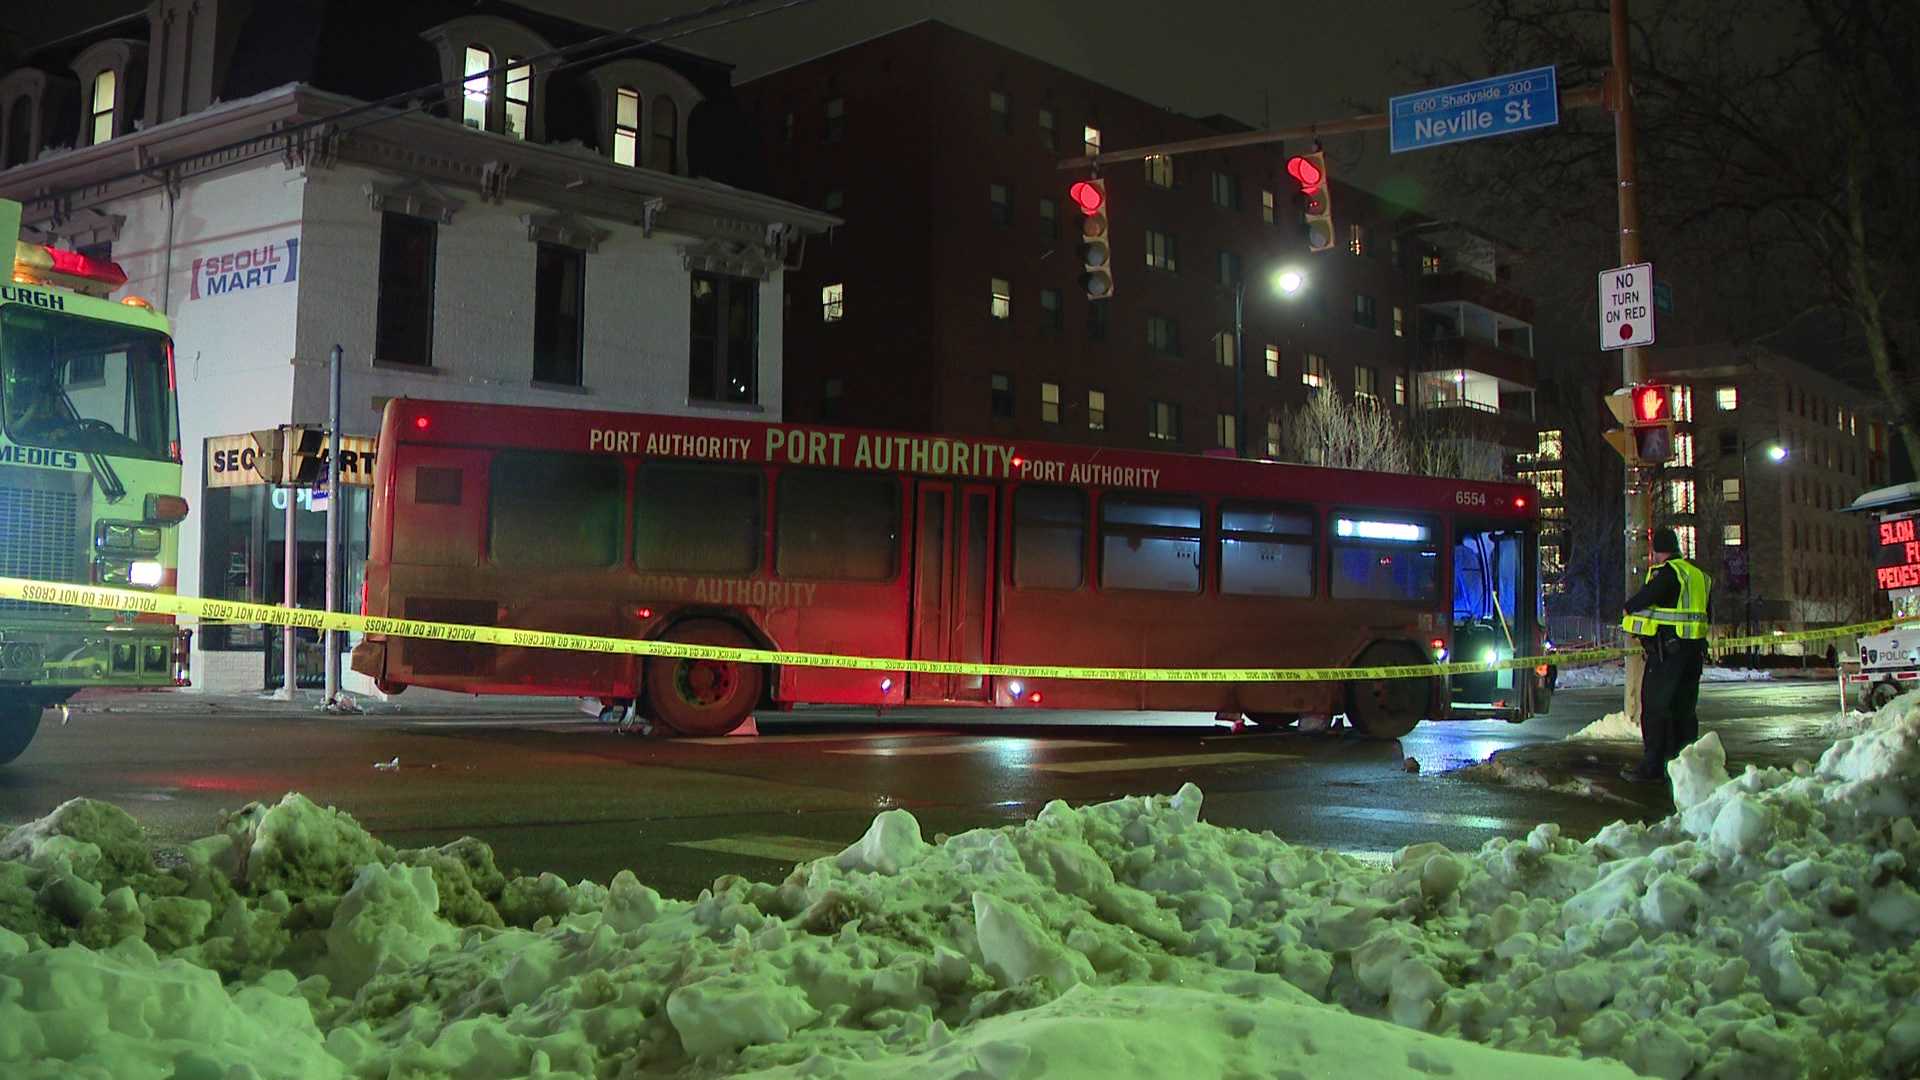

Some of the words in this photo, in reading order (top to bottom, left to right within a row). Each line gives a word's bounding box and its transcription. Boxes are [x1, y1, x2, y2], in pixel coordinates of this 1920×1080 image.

[1413, 99, 1436, 113] 600
[1441, 87, 1500, 109] Shadyside
[1508, 80, 1532, 96] 200
[1415, 108, 1493, 141] Neville
[1504, 98, 1532, 124] St
[206, 244, 280, 276] SEOUL
[207, 264, 277, 296] MART
[1616, 272, 1634, 289] NO
[1611, 291, 1640, 306] TURN
[1606, 310, 1620, 323] ON
[1625, 306, 1646, 320] RED
[589, 428, 641, 454] PORT
[646, 432, 751, 460] AUTHORITY
[766, 427, 845, 467] PORT
[854, 434, 1015, 479] AUTHORITY
[1021, 458, 1065, 482] PORT
[1069, 463, 1160, 489] AUTHORITY
[1456, 490, 1486, 506] 6554
[1880, 519, 1915, 545] SLOW
[22, 584, 56, 600] CROSS
[59, 588, 79, 603] NOT
[81, 591, 96, 606] DO
[695, 578, 816, 606] AUTHORITY
[99, 593, 120, 608] LINE
[124, 597, 157, 612] POLICE
[202, 602, 233, 618] CROSS
[235, 606, 254, 620] NOT
[255, 608, 269, 621] DO
[272, 610, 291, 624] LINE
[292, 613, 324, 627] POLICE
[364, 618, 393, 633] CROSS
[394, 622, 411, 635] NOT
[413, 624, 425, 636] DO
[426, 625, 446, 638] LINE
[447, 627, 476, 640] POLICE
[513, 632, 539, 645] CROSS
[540, 634, 556, 647] NOT
[570, 638, 587, 649] LINE
[588, 640, 615, 651] POLICE
